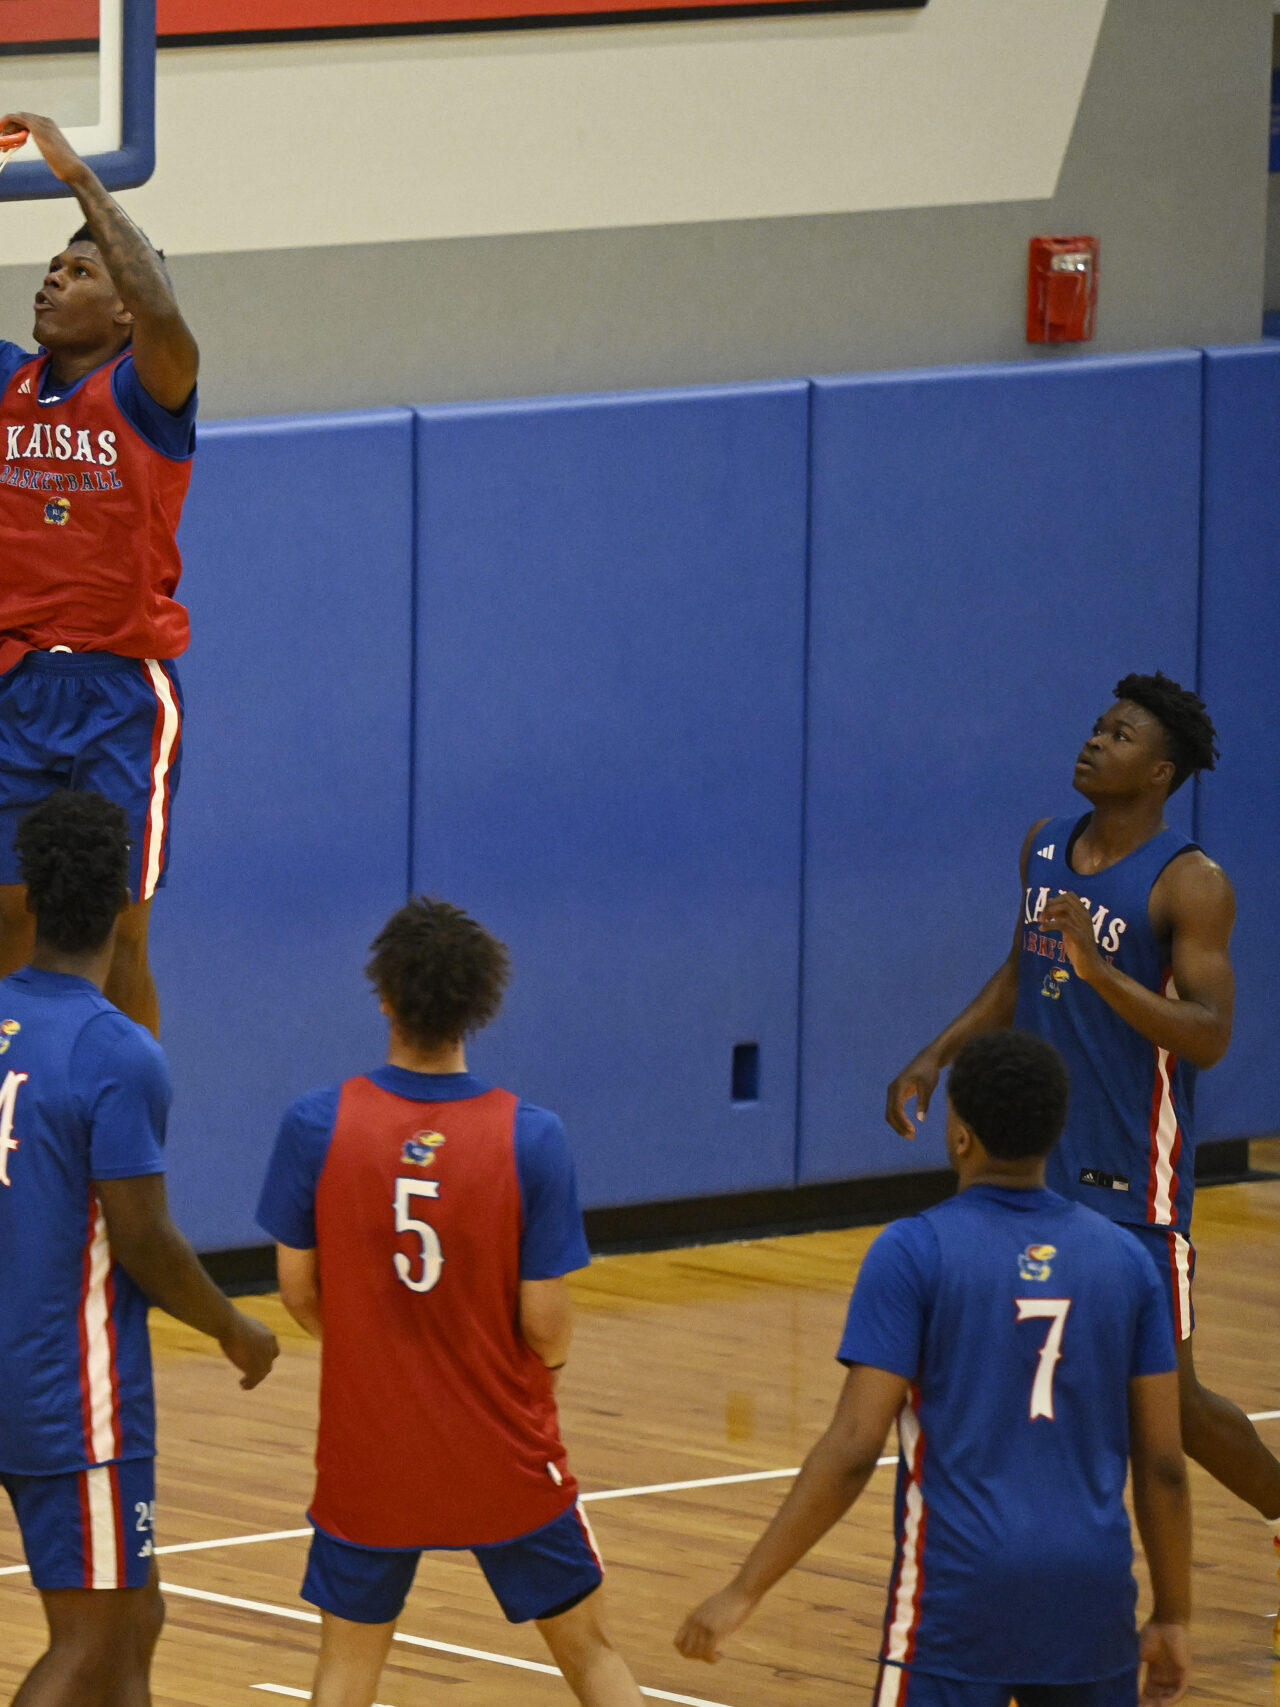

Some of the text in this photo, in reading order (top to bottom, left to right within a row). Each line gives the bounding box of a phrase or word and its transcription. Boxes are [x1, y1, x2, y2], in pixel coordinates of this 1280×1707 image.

[0, 464, 123, 492] BASKETBALL
[1024, 886, 1128, 953] AAS
[392, 1176, 446, 1293] 5
[1013, 1298, 1072, 1423] 7
